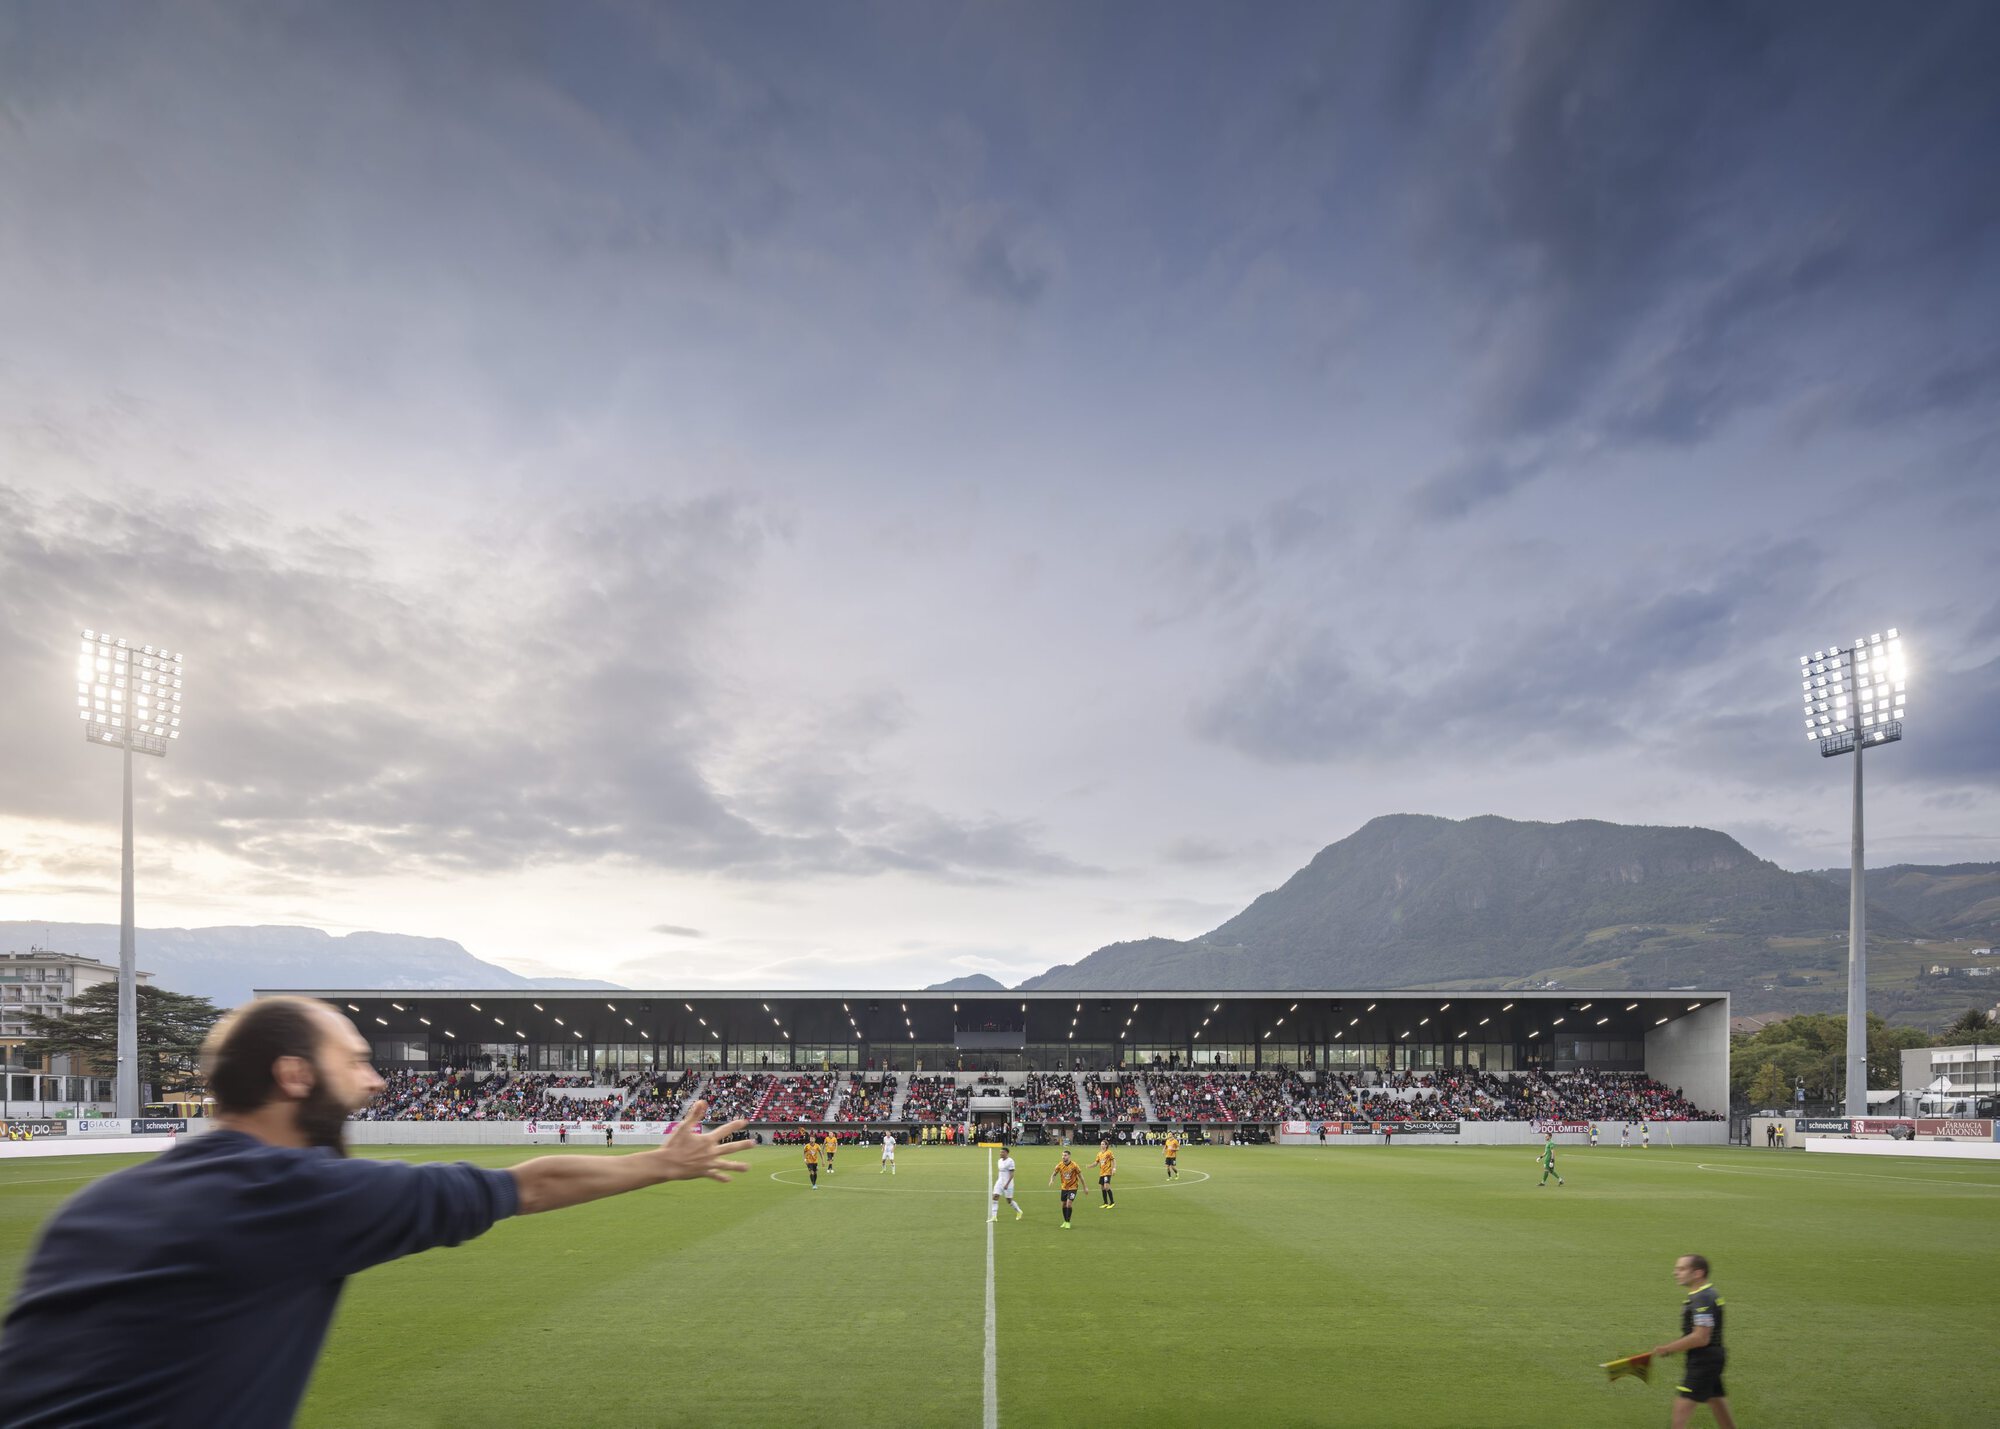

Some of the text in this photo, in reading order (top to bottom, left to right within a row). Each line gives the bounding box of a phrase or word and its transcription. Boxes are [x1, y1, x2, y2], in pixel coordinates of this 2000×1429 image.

[89, 1120, 121, 1128] GIACCA
[146, 1121, 185, 1130] schneeberg.it
[1404, 1122, 1429, 1130] SALON
[1428, 1122, 1456, 1130] MIRAGE
[1809, 1121, 1848, 1130] schneeberg.it
[1945, 1121, 1982, 1129] FARMACIA
[1541, 1125, 1589, 1133] DOLOMITES
[1936, 1127, 1983, 1135] MADONNA
